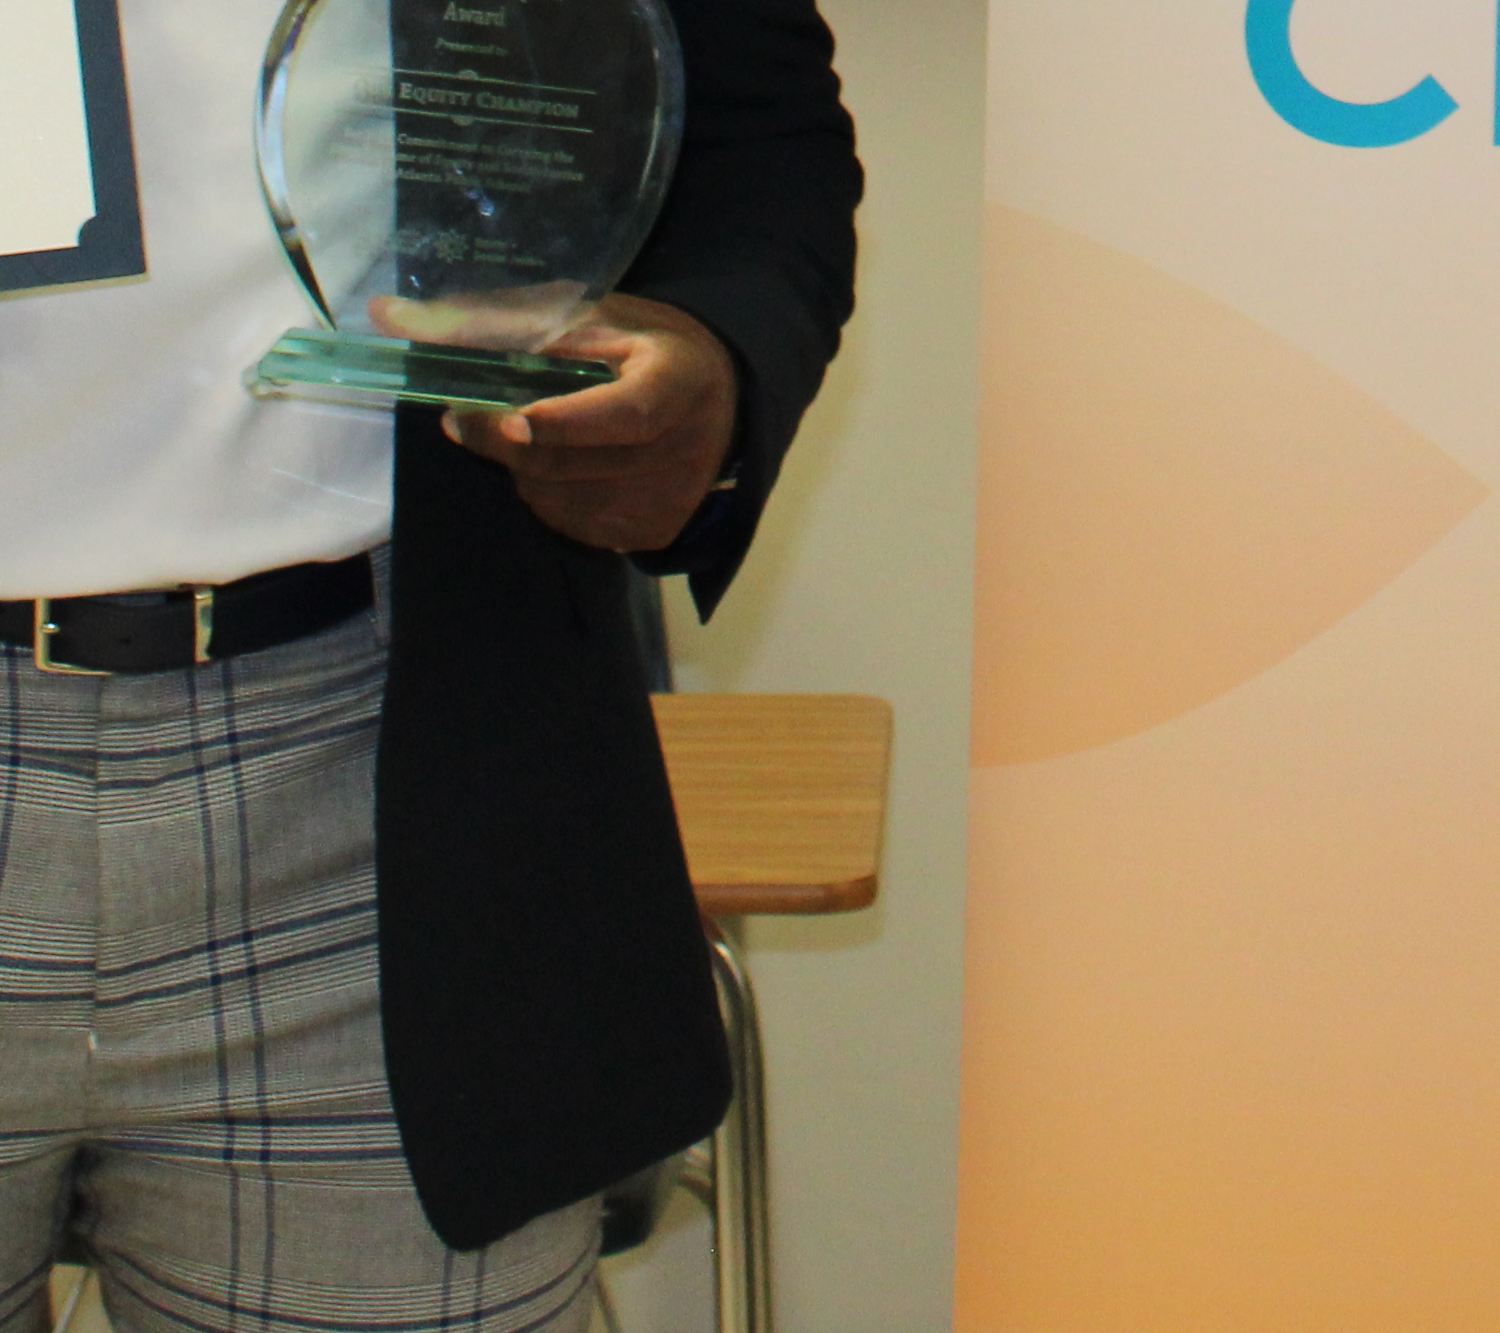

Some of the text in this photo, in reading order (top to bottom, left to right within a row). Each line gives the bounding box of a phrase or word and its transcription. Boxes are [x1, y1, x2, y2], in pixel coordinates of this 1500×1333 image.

[442, 1, 507, 28] Award
[399, 82, 472, 106] EQUITY
[476, 90, 581, 119] CHAMPION
